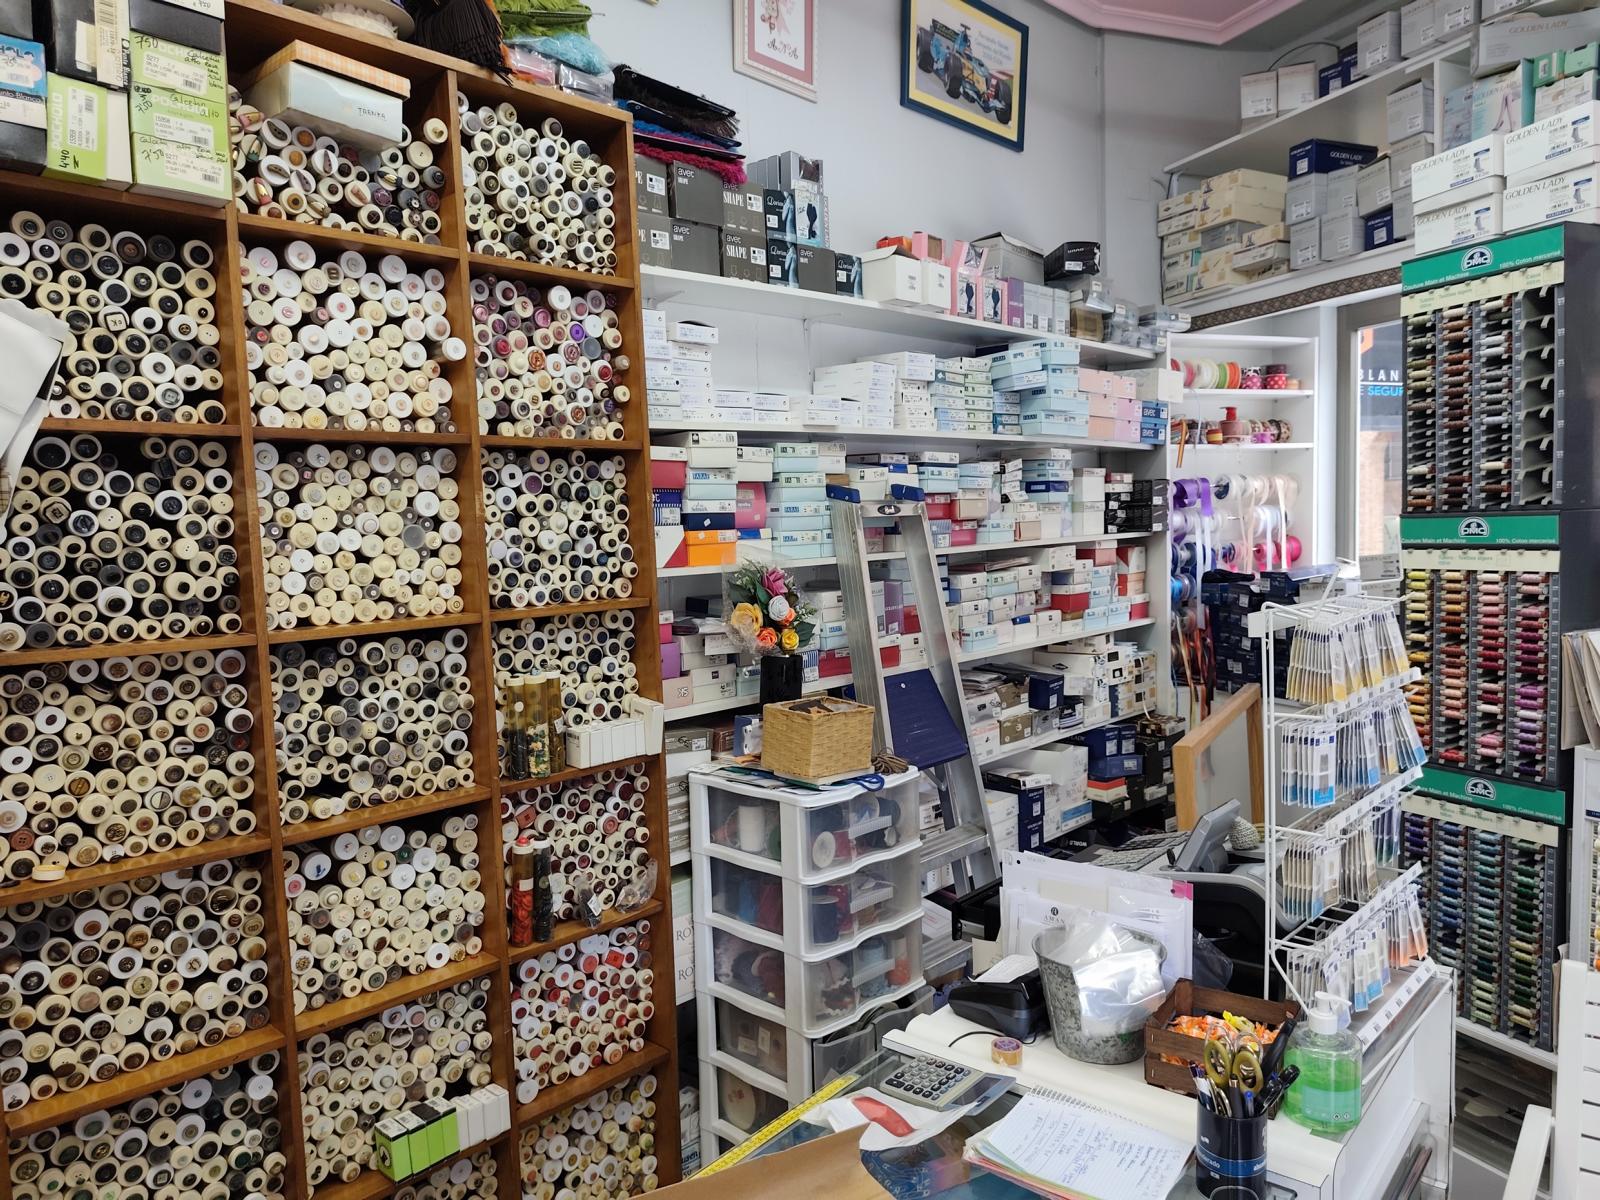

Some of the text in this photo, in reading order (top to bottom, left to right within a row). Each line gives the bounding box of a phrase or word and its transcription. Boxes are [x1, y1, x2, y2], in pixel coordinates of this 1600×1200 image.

[1506, 116, 1564, 145] GOLDEN LADY
[1413, 147, 1467, 173] GOLDEN LADY
[678, 167, 695, 179] avec
[1505, 175, 1567, 201] GOLDEN LADY
[723, 191, 744, 207] SHAPE
[1416, 204, 1470, 226] GOLDEN LADY
[673, 224, 690, 235] avec
[726, 233, 742, 244] avec
[726, 244, 747, 259] SHAPE
[1463, 257, 1491, 269] DMC
[1468, 786, 1494, 798] DMC
